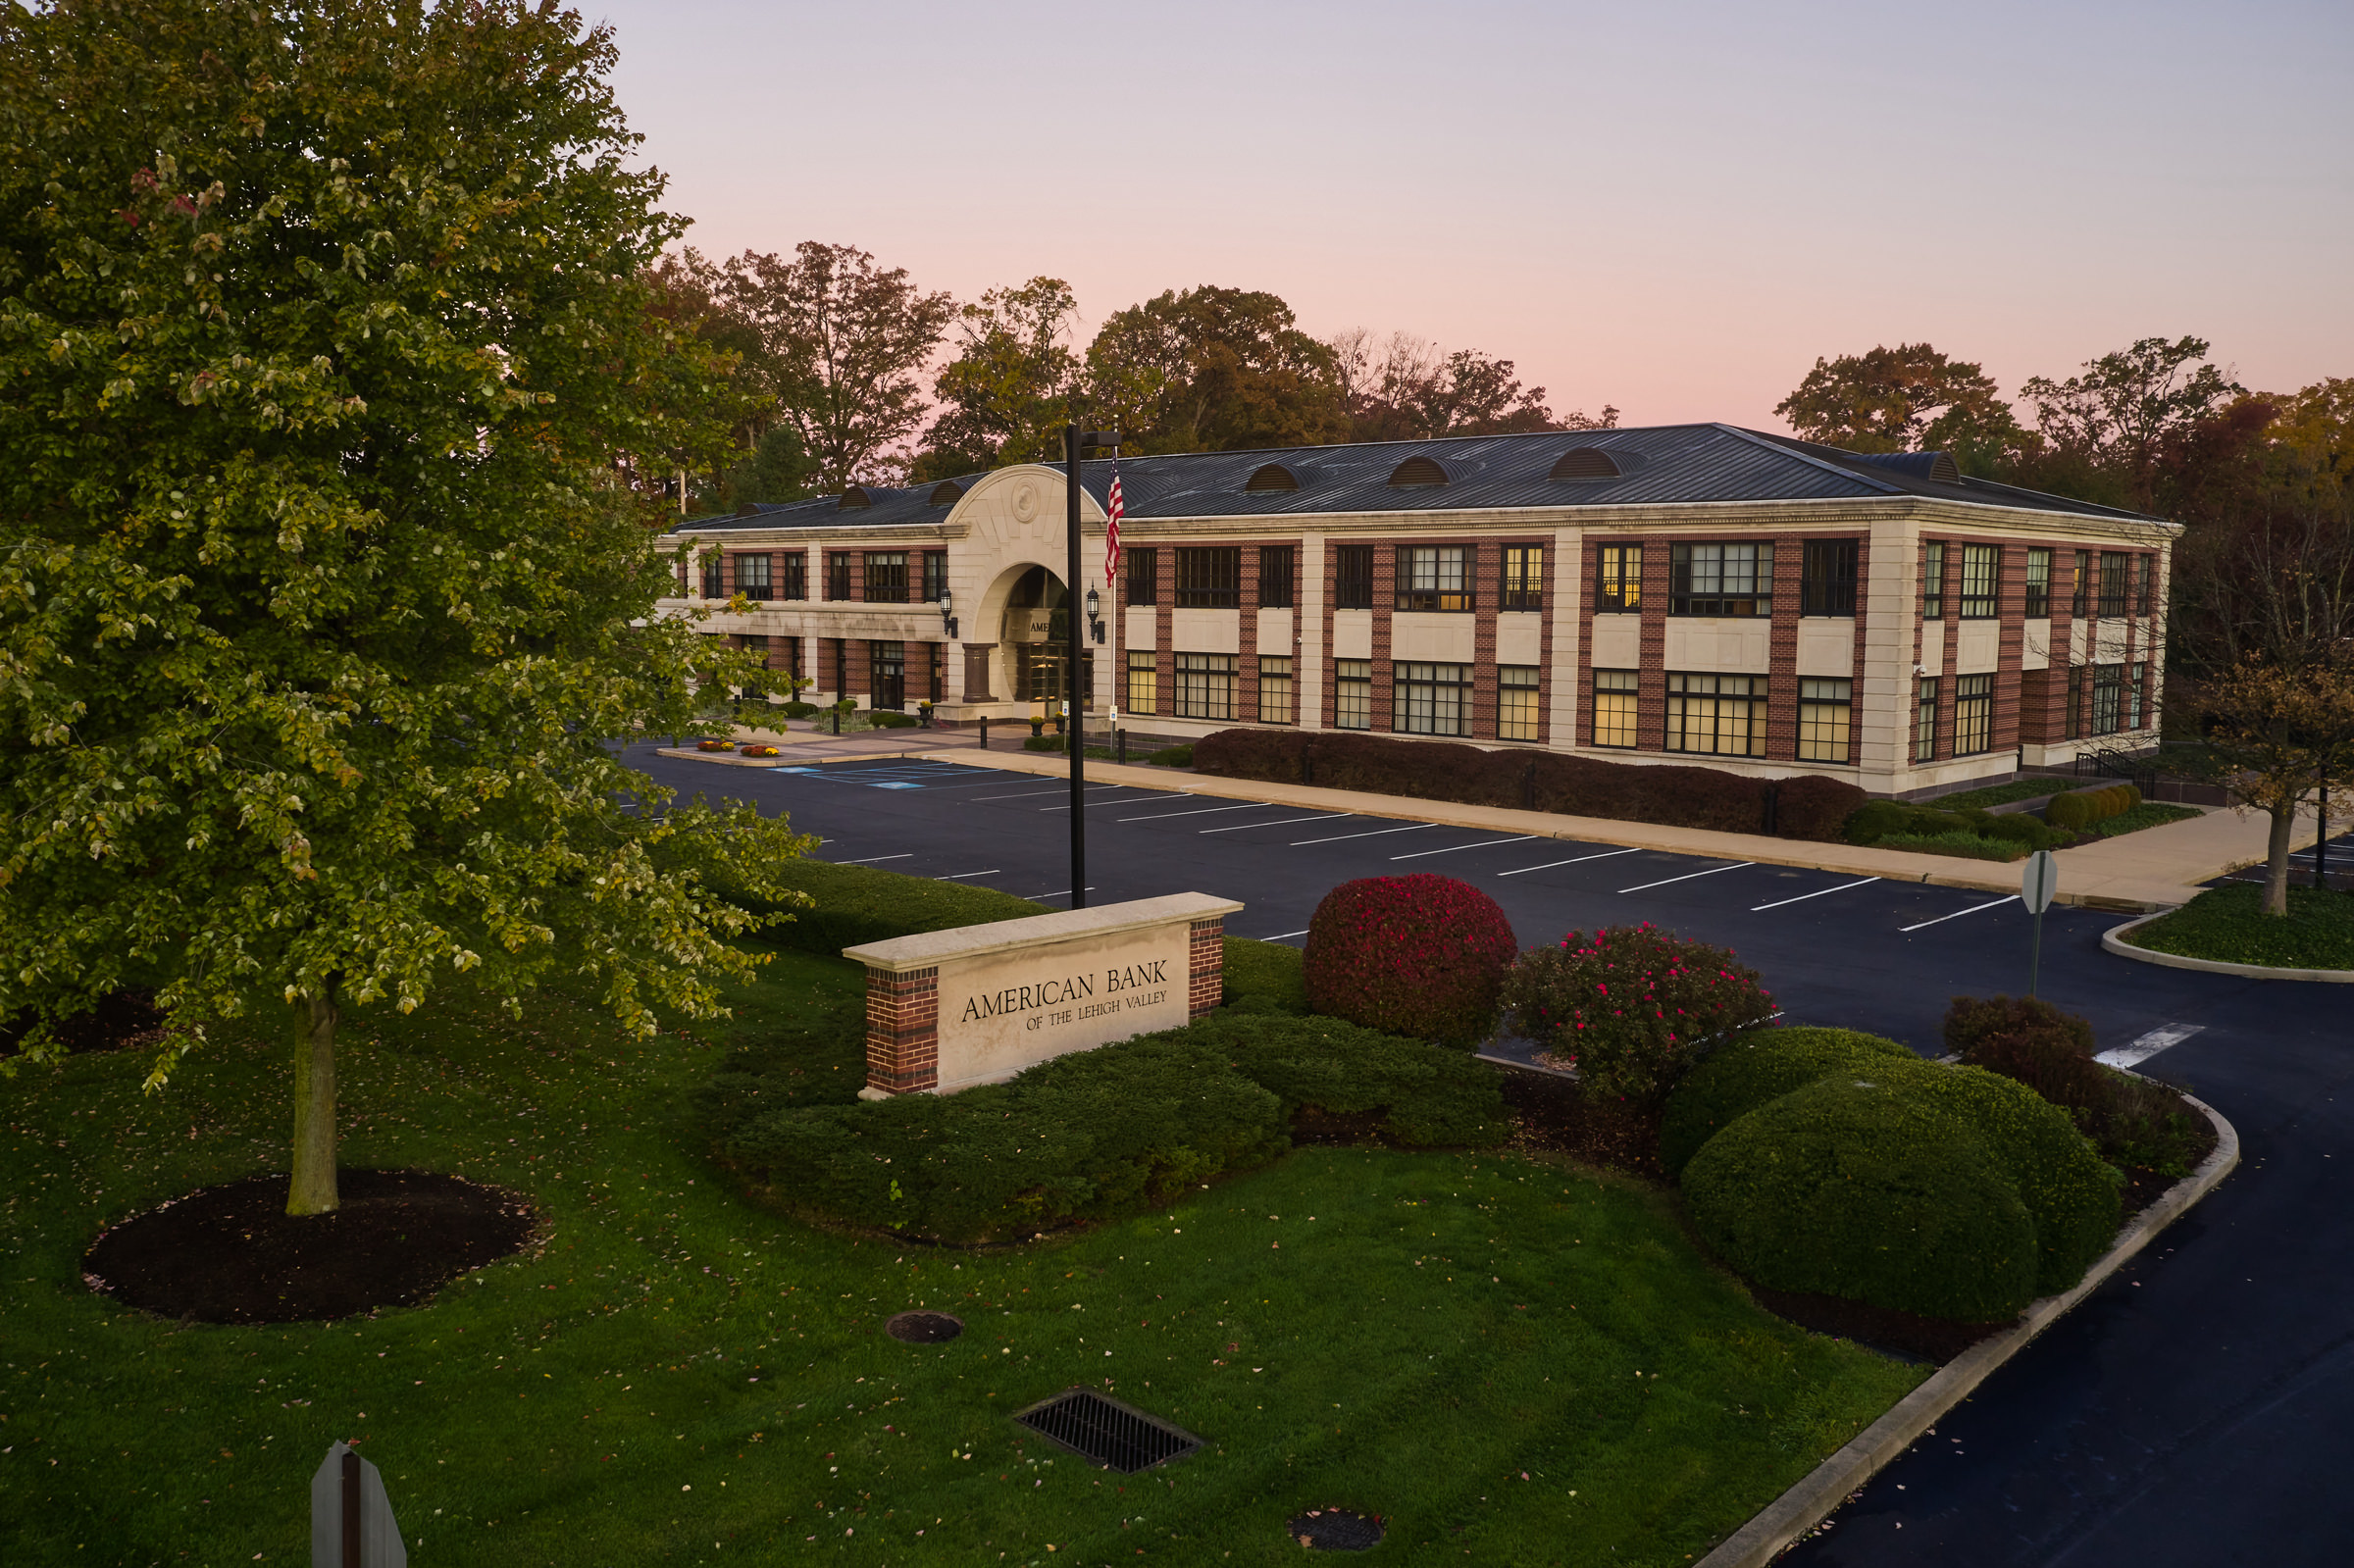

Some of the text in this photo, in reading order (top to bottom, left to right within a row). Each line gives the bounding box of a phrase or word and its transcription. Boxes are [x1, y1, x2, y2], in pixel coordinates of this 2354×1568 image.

[961, 960, 1167, 1023] AMERICAN BANK
[1027, 990, 1167, 1031] OF THE LEHIGH VALLEY
